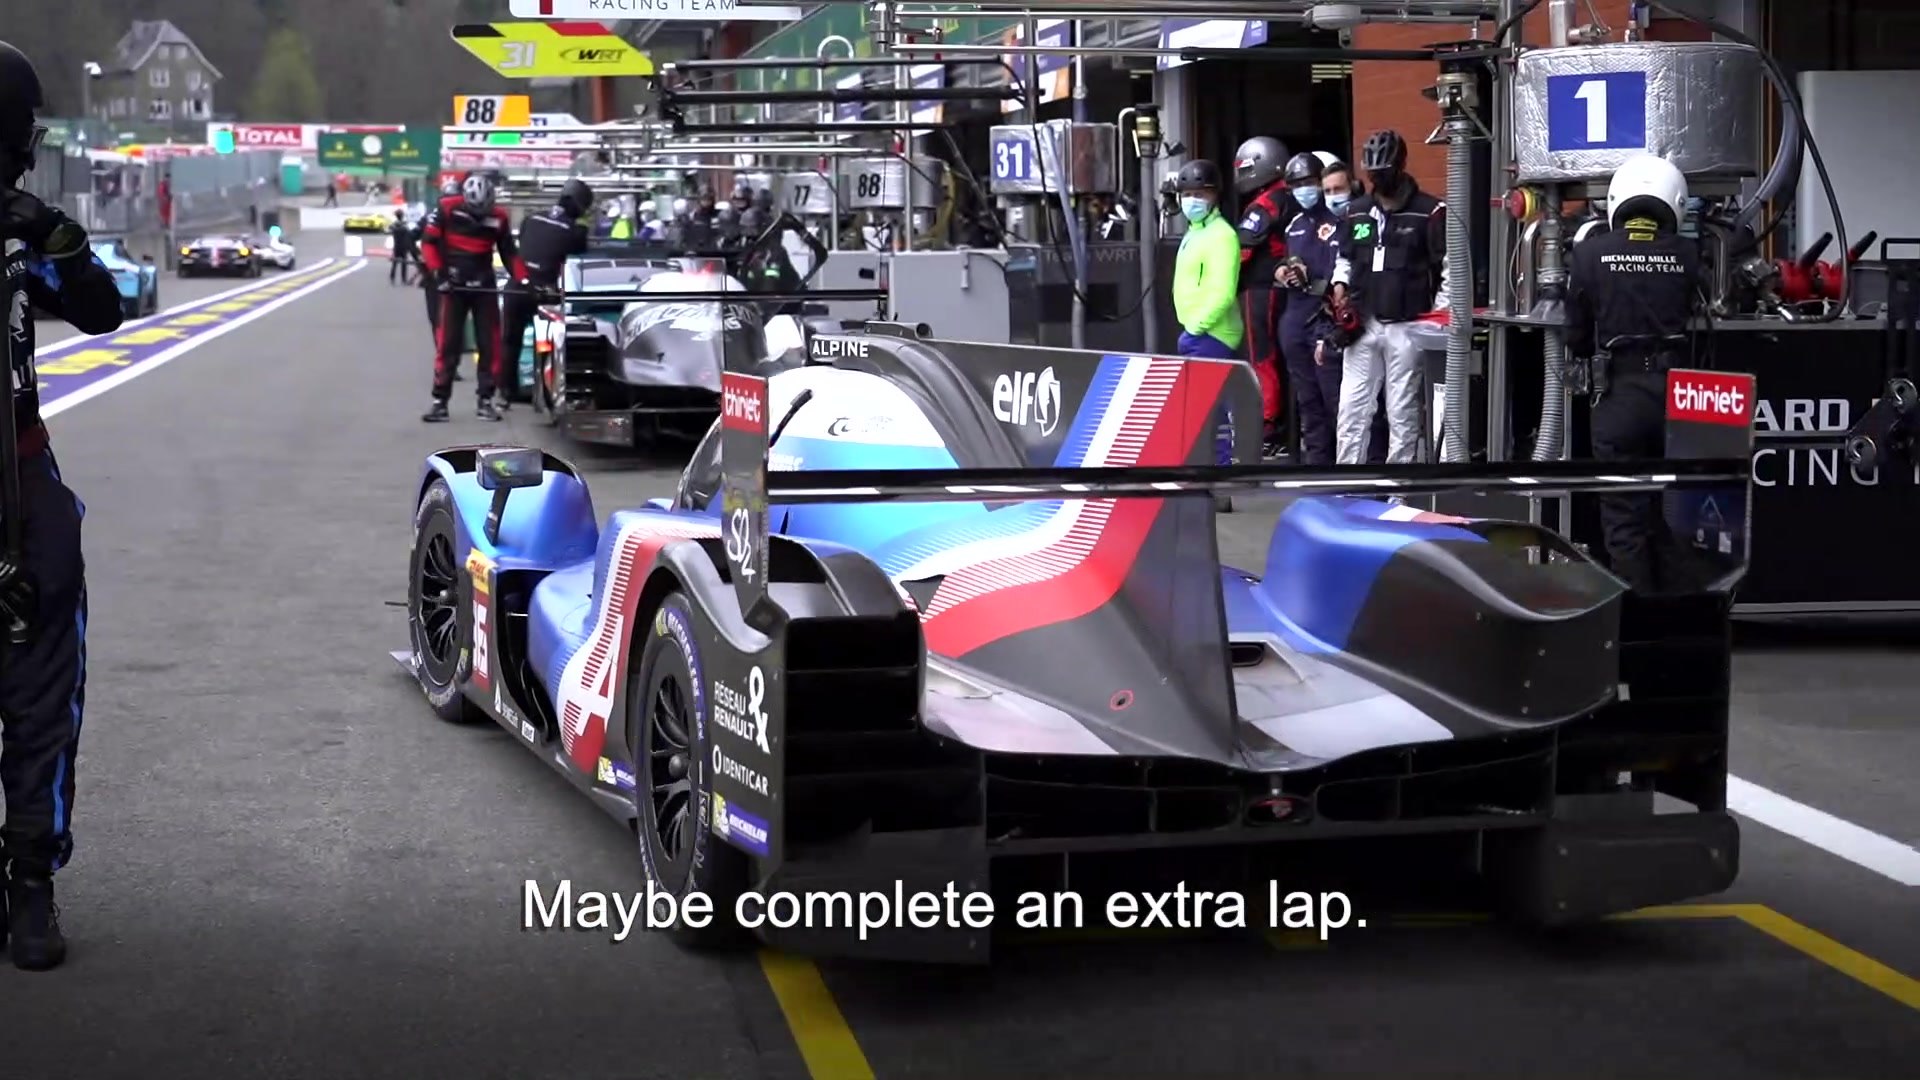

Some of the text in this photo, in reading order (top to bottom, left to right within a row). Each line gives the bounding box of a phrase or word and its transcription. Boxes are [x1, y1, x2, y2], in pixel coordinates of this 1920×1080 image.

[589, 0, 735, 10] RACING TEAM
[500, 41, 628, 68] 31 WRT
[465, 98, 496, 123] 88
[1574, 80, 1608, 143] 1
[236, 127, 299, 144] TOTAL
[996, 142, 1023, 178] 31
[794, 184, 811, 206] 77
[858, 173, 880, 198] 88
[1601, 254, 1677, 264] RICHARD MILLE
[1609, 263, 1685, 273] RACING TEAM
[812, 339, 869, 359] ALPINE
[724, 386, 761, 423] thiriet
[992, 371, 1036, 426] elf
[1673, 379, 1745, 417] thiriet
[714, 680, 747, 716] RÉSEAU
[714, 704, 756, 742] RENAULT
[722, 760, 769, 797] IDENTICAR
